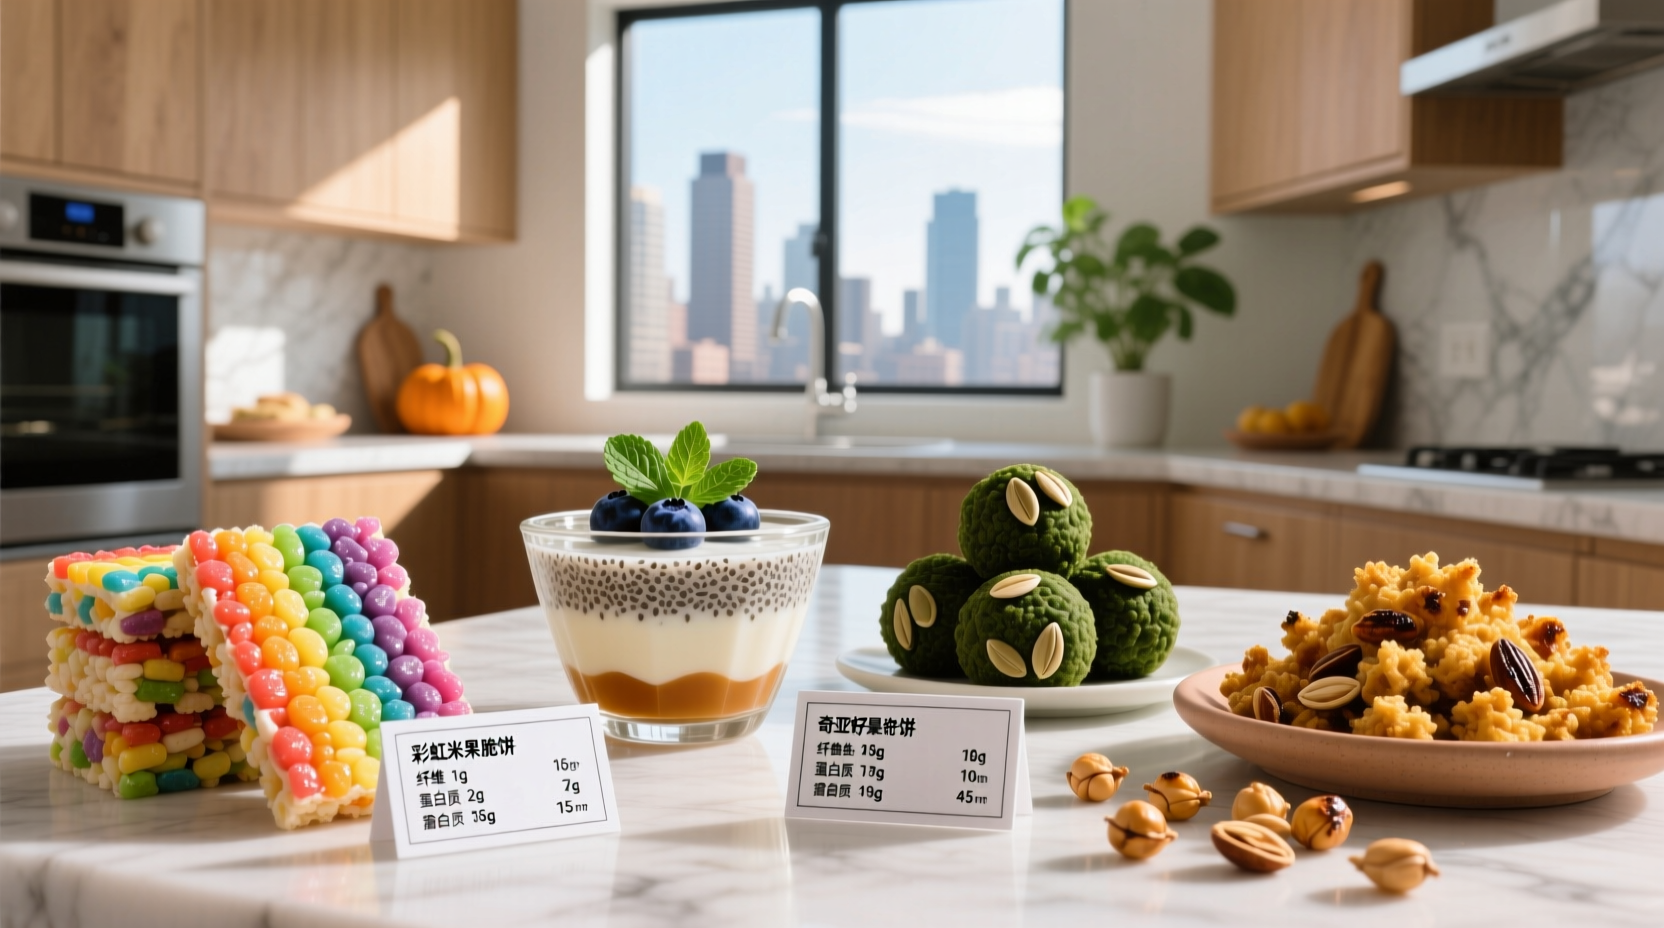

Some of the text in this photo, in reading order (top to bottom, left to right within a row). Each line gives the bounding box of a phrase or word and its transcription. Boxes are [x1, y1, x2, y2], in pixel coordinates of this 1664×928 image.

[411, 736, 516, 765] 彩虹米果脆饼
[452, 770, 468, 784] 1g
[467, 789, 485, 804] 2g
[562, 779, 580, 795] 7g
